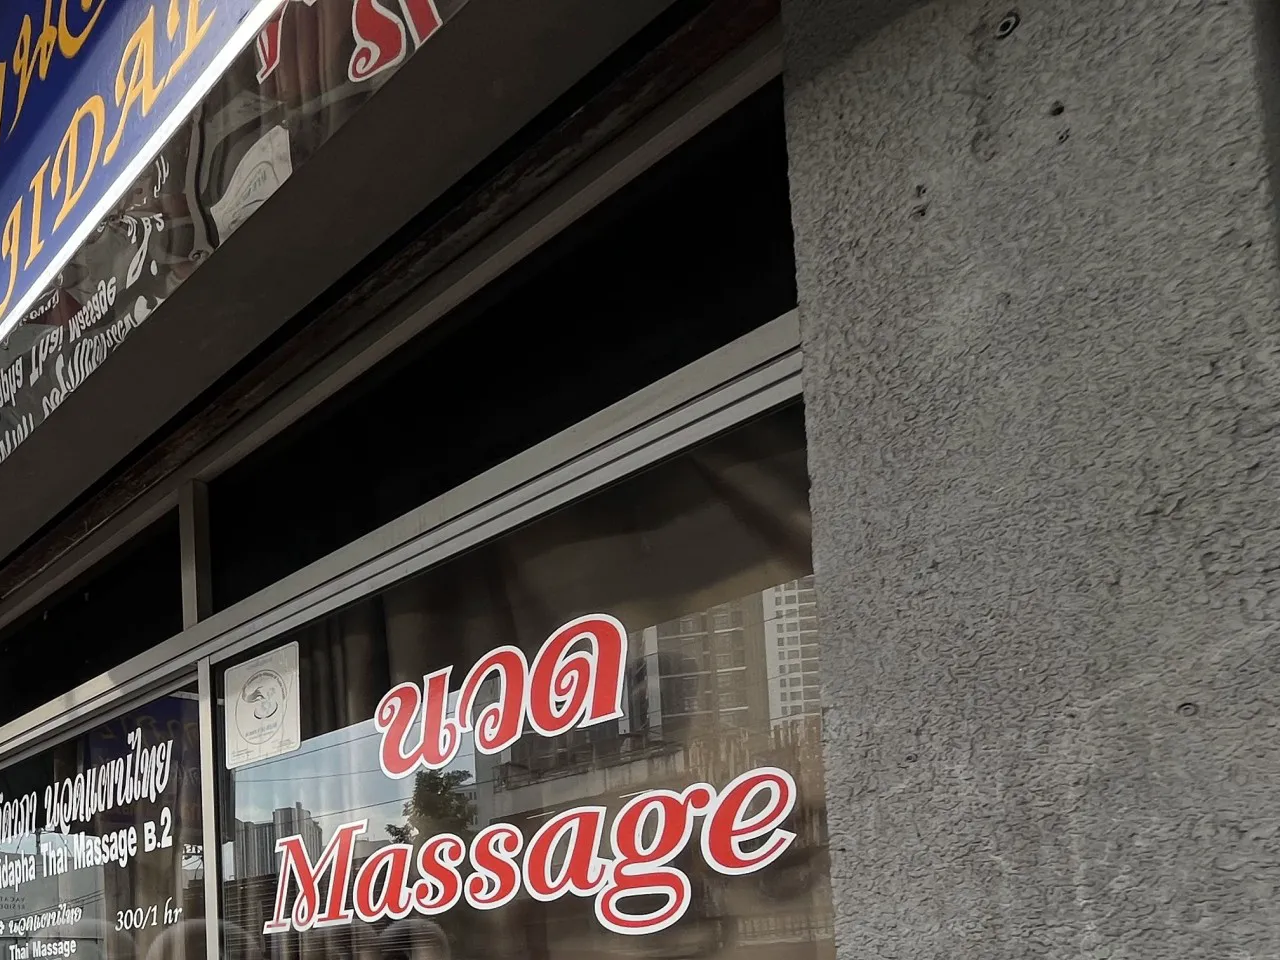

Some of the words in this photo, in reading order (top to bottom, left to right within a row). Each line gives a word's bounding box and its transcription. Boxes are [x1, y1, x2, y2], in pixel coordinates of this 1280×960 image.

[374, 613, 629, 780] นวด
[44, 727, 173, 835] นวดแผนไทย
[41, 840, 68, 878] Thai
[74, 826, 137, 868] Massage
[144, 807, 172, 852] B.2
[263, 766, 798, 935] Massage
[8, 903, 83, 935] นวดแผนไทย
[115, 905, 158, 931] 300/1
[164, 897, 183, 925] hr
[9, 943, 29, 960] Thai
[32, 940, 77, 957] Massage
